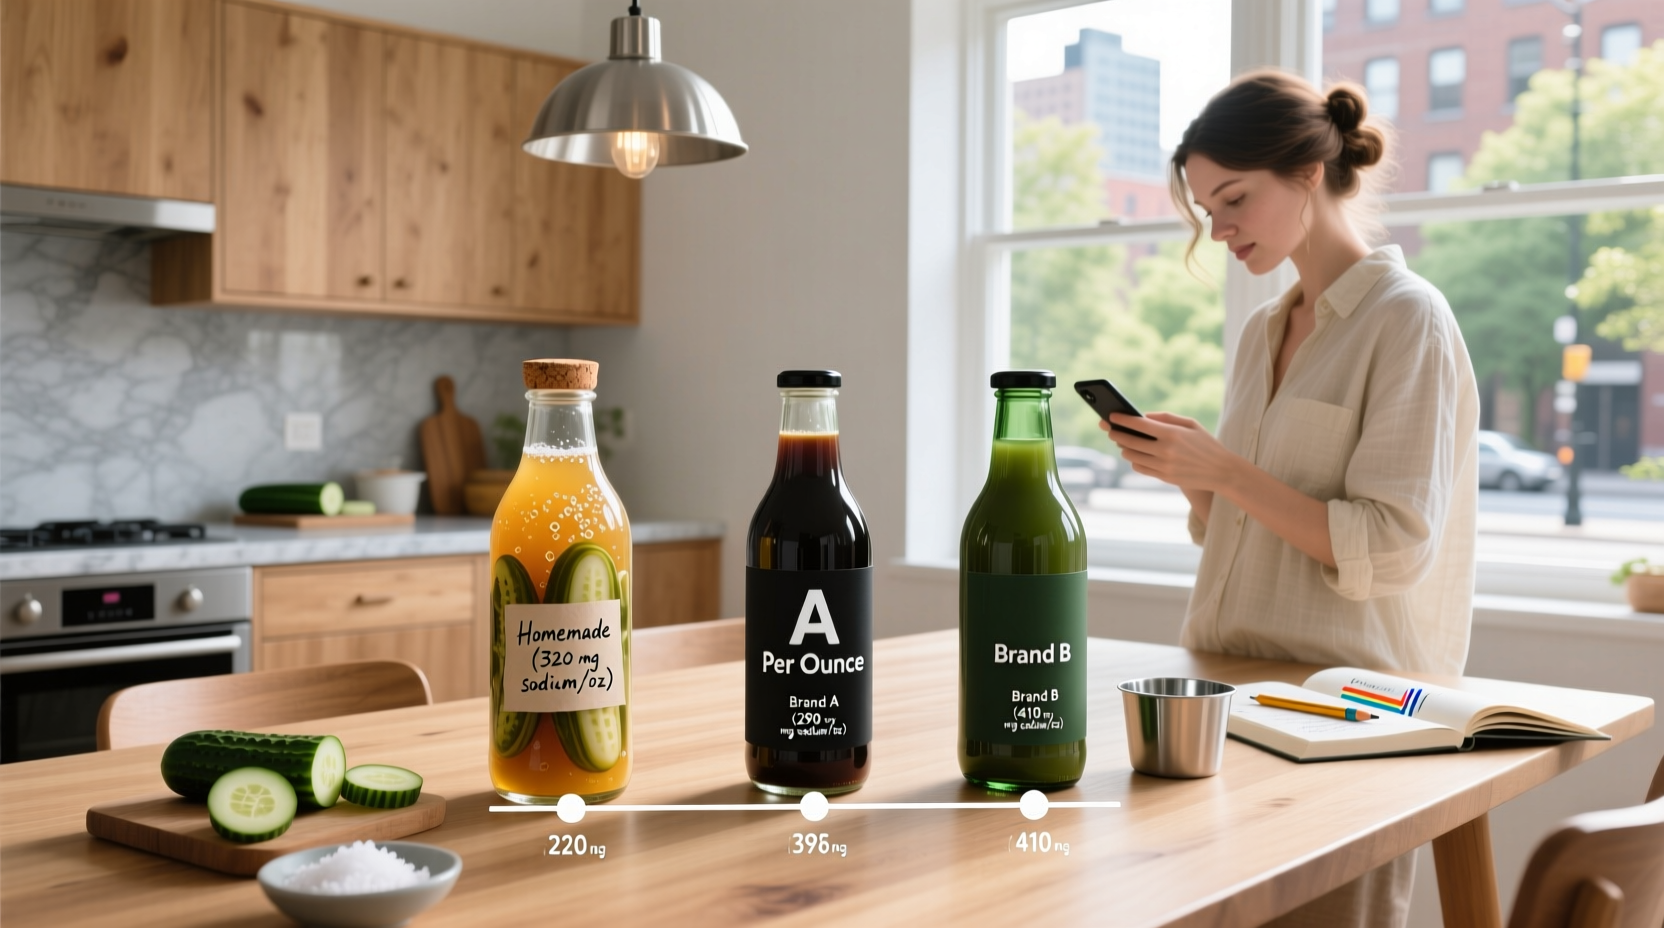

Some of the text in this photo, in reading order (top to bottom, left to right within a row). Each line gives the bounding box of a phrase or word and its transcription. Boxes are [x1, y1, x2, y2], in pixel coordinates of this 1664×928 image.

[788, 588, 840, 645] A
[517, 617, 611, 646] Homemade
[532, 646, 599, 673] (320 mg
[762, 650, 865, 675] Per Ounce
[994, 642, 1072, 664] Brand B
[520, 666, 613, 695] sodium/oz)
[789, 694, 840, 708] Brand A
[1011, 688, 1059, 703] Brand B
